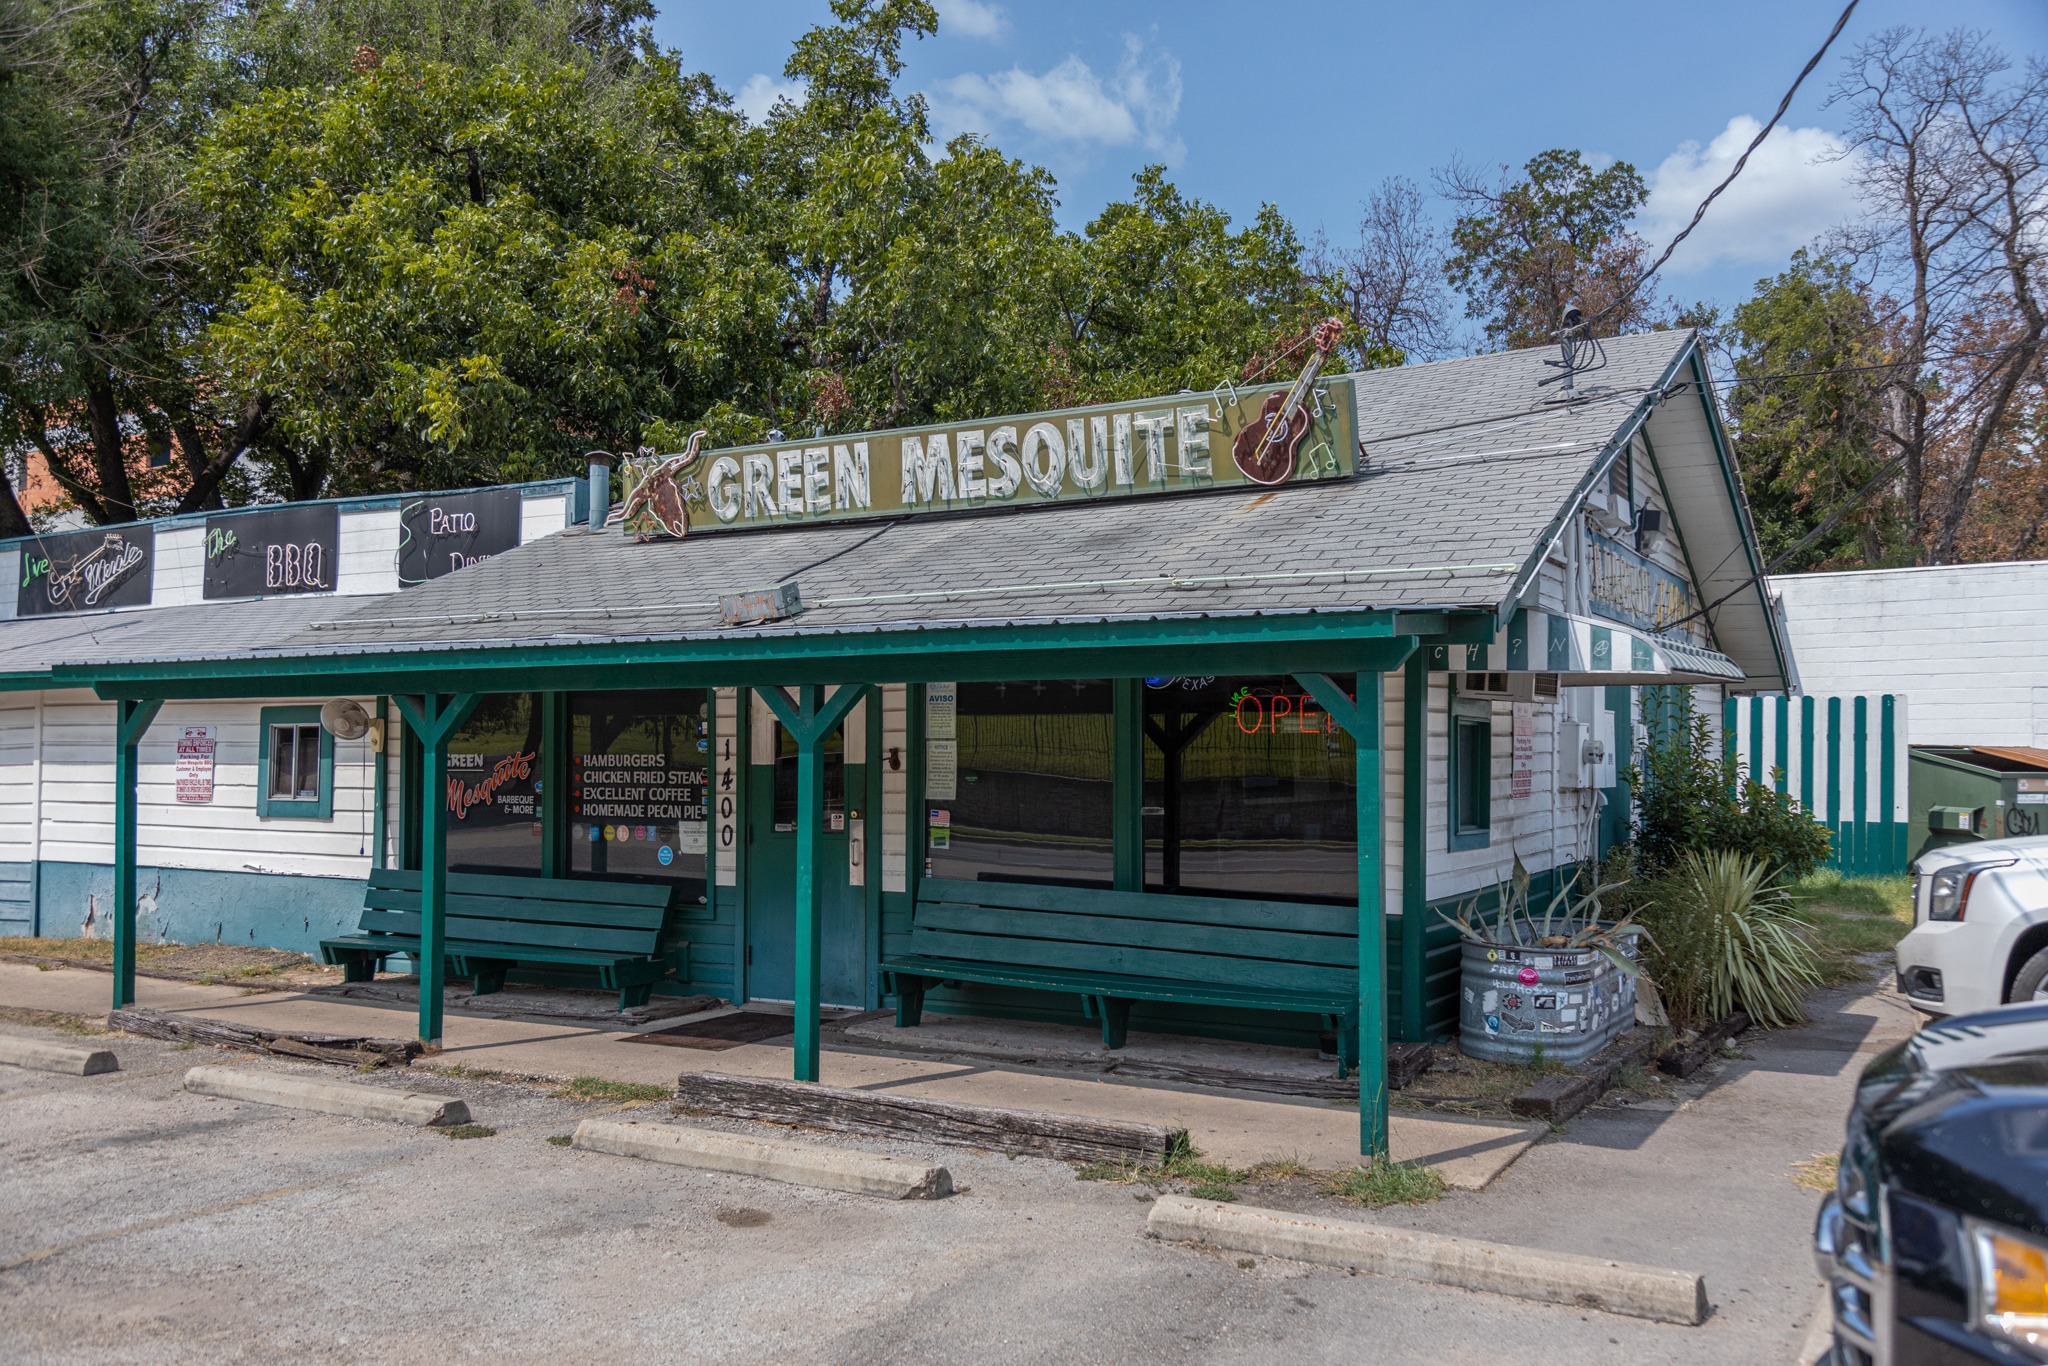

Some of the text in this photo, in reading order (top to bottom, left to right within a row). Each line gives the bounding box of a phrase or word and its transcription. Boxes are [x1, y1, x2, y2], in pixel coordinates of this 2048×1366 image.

[708, 404, 1213, 522] GREEN MESQUITE
[430, 508, 475, 534] PATIO
[22, 552, 50, 587] Live
[267, 543, 328, 588] BBQ
[1176, 676, 1215, 691] EXAS
[583, 754, 665, 767] HAMBURGERS
[446, 751, 536, 819] Mesquite
[583, 771, 703, 785] CHICKEN FRIED STEAK
[497, 795, 535, 804] BARBEQUE
[583, 787, 692, 801] EXCELLENT COFFEE
[504, 805, 534, 814] & MORE
[583, 804, 702, 819] HOMEMADE PECAN PIE
